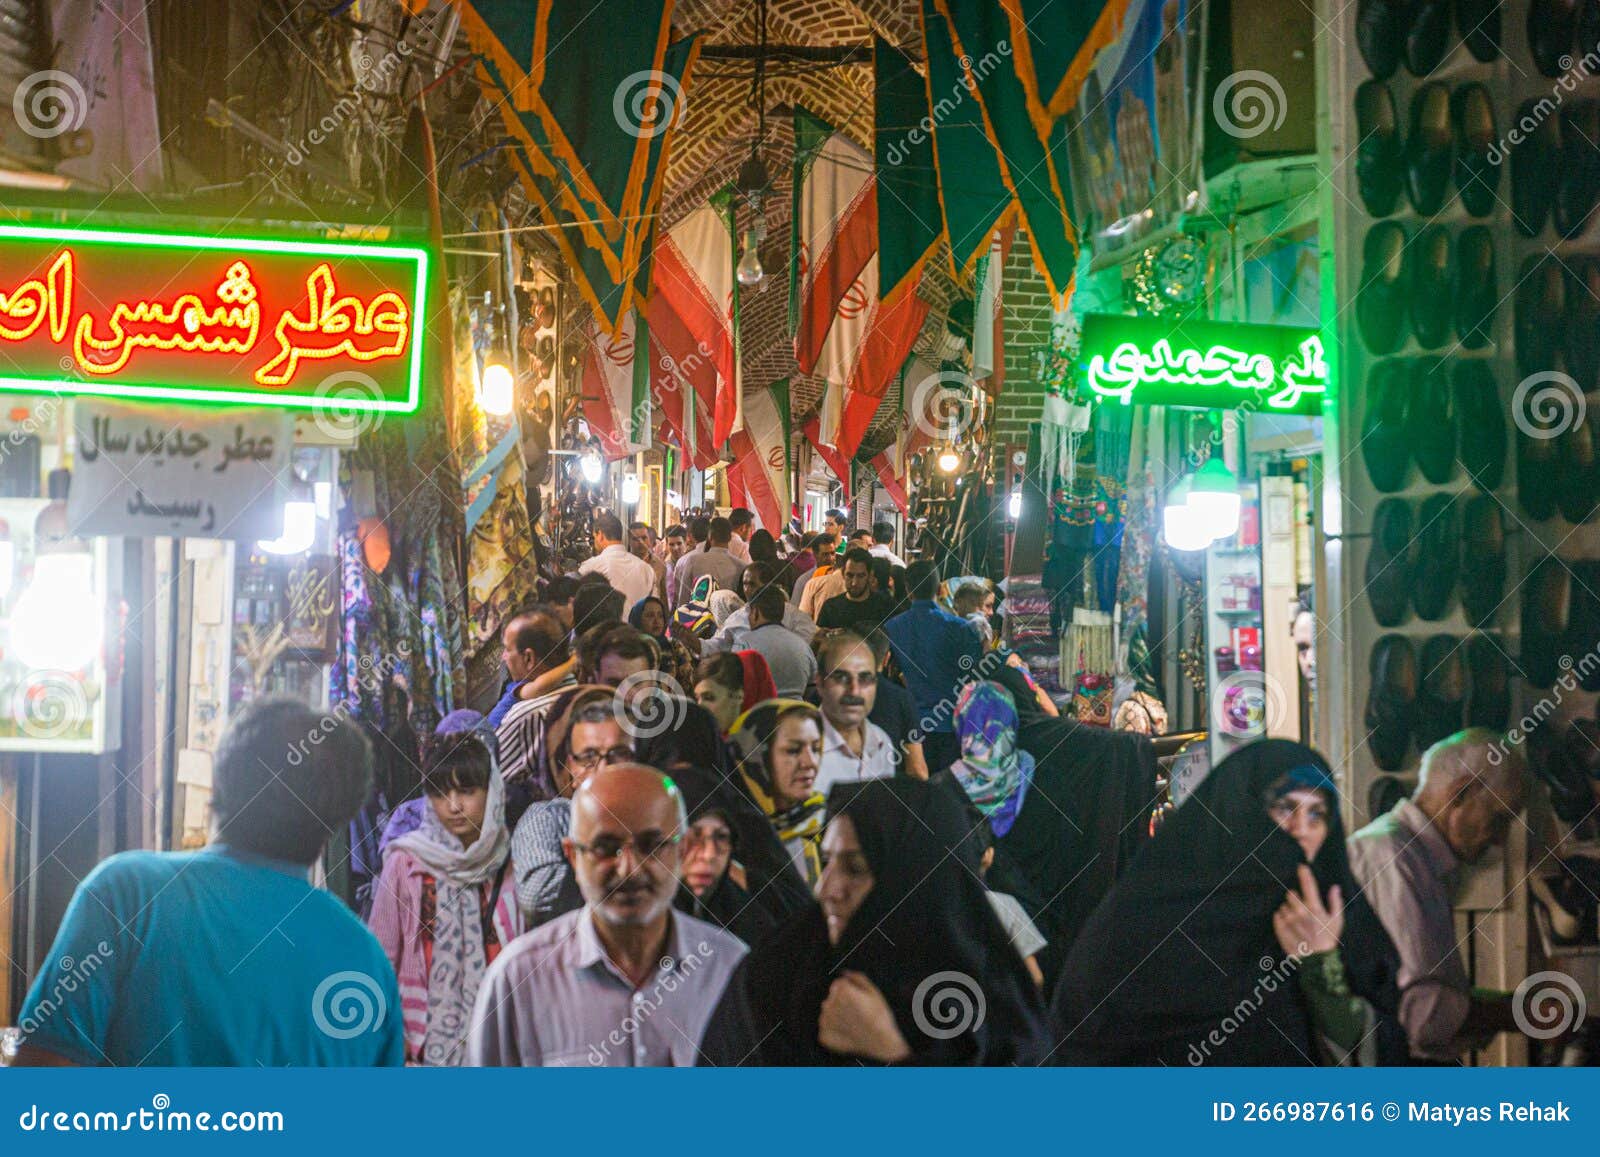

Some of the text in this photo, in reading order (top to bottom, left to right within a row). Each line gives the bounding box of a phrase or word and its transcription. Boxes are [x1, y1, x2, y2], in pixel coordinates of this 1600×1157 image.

[0, 249, 409, 386] عطر شمس اص
[80, 415, 131, 461] سال
[213, 425, 273, 472] عطر
